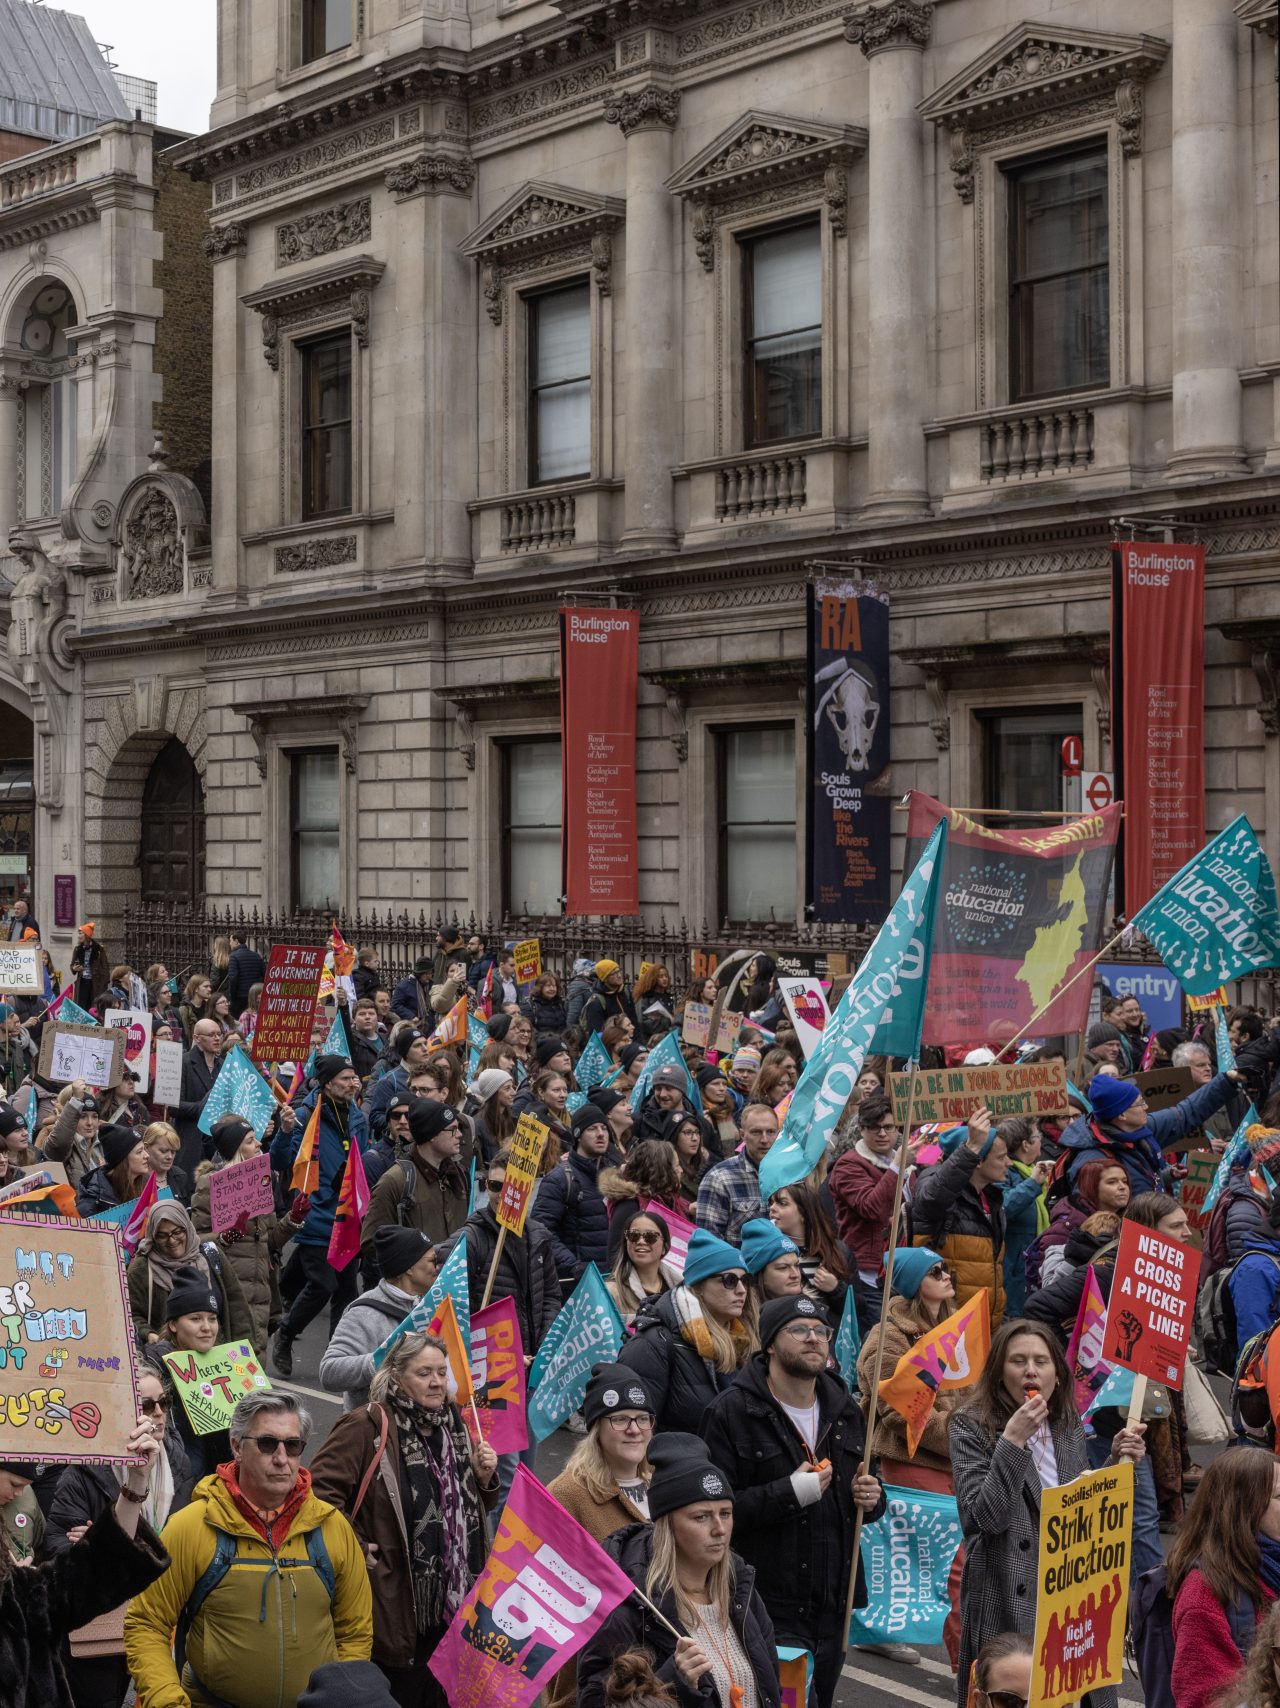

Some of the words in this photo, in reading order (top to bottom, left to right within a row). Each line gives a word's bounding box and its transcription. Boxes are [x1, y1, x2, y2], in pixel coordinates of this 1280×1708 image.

[1128, 551, 1195, 573] Burlington
[1128, 569, 1170, 586] House
[570, 615, 630, 632] Burlington
[821, 595, 862, 651] RA
[570, 629, 608, 643] House
[588, 735, 605, 743] Royal
[588, 743, 614, 752] Academy
[594, 750, 608, 759] Arts
[587, 767, 618, 776] Geological
[821, 772, 851, 785] Souls
[587, 775, 608, 784] Society
[587, 791, 604, 799] Royal
[826, 785, 862, 798] Grown
[587, 799, 608, 808] Society
[833, 797, 862, 812] Deep
[587, 807, 619, 816] Chemistry
[832, 809, 851, 821] like
[587, 823, 609, 832] Society
[836, 821, 853, 834] the
[588, 831, 622, 840] Antiquaries
[836, 834, 869, 847] Rivers
[588, 846, 605, 854] Royal
[588, 854, 629, 862] Astronomical
[588, 862, 610, 871] Society
[590, 878, 614, 886] Linnean
[1204, 857, 1272, 920] national
[590, 886, 612, 895] Society
[970, 882, 1013, 899] national
[945, 889, 1025, 917] education
[964, 910, 996, 924] union
[1160, 900, 1210, 944] union
[284, 950, 298, 964] IF
[300, 951, 318, 965] THE
[515, 951, 539, 963] education
[777, 956, 801, 968] Souls
[268, 965, 320, 980] GOVERNMENT
[694, 953, 719, 982] RA
[783, 965, 810, 977] Grown
[265, 982, 280, 996] CAN
[280, 983, 318, 997] NEGOTIATE
[1115, 974, 1178, 1001] entry
[267, 998, 286, 1012] WITH
[287, 998, 299, 1012] THE
[300, 999, 312, 1012] EU
[262, 1014, 280, 1028] WHY
[127, 1029, 141, 1041] OUR
[257, 1030, 306, 1044] NEGOTIATE
[256, 1046, 274, 1059] WITH
[276, 1047, 289, 1059] THE
[927, 1074, 944, 1095] BE
[948, 1073, 964, 1093] IN
[967, 1070, 1002, 1092] YOUR
[1006, 1065, 1062, 1092] SCHOOLS
[912, 1099, 938, 1121] THE
[939, 1095, 981, 1119] TORIES
[984, 1091, 1032, 1117] WEREN'T
[1034, 1089, 1068, 1112] TOOLS
[213, 1175, 224, 1187] We
[227, 1167, 243, 1181] teach
[245, 1162, 257, 1173] kids
[216, 1180, 244, 1199] STAND
[247, 1173, 260, 1187] UP
[214, 1202, 229, 1213] Now
[243, 1191, 255, 1201] our
[216, 1214, 233, 1227] Save
[1137, 1234, 1185, 1270] NEVER
[15, 1246, 75, 1287] WET
[1134, 1257, 1183, 1292] CROSS
[1120, 1276, 1132, 1295] A
[1135, 1281, 1187, 1318] PICKET
[1148, 1310, 1185, 1342] LINE!
[77, 1355, 121, 1372] THESE
[166, 1354, 233, 1384] Where's
[487, 1318, 521, 1406] PAY
[211, 1376, 244, 1404] The
[1061, 1485, 1093, 1509] Socialist
[1099, 1496, 1129, 1534] for
[871, 1544, 889, 1595] union
[887, 1499, 917, 1635] education
[917, 1535, 936, 1603] national
